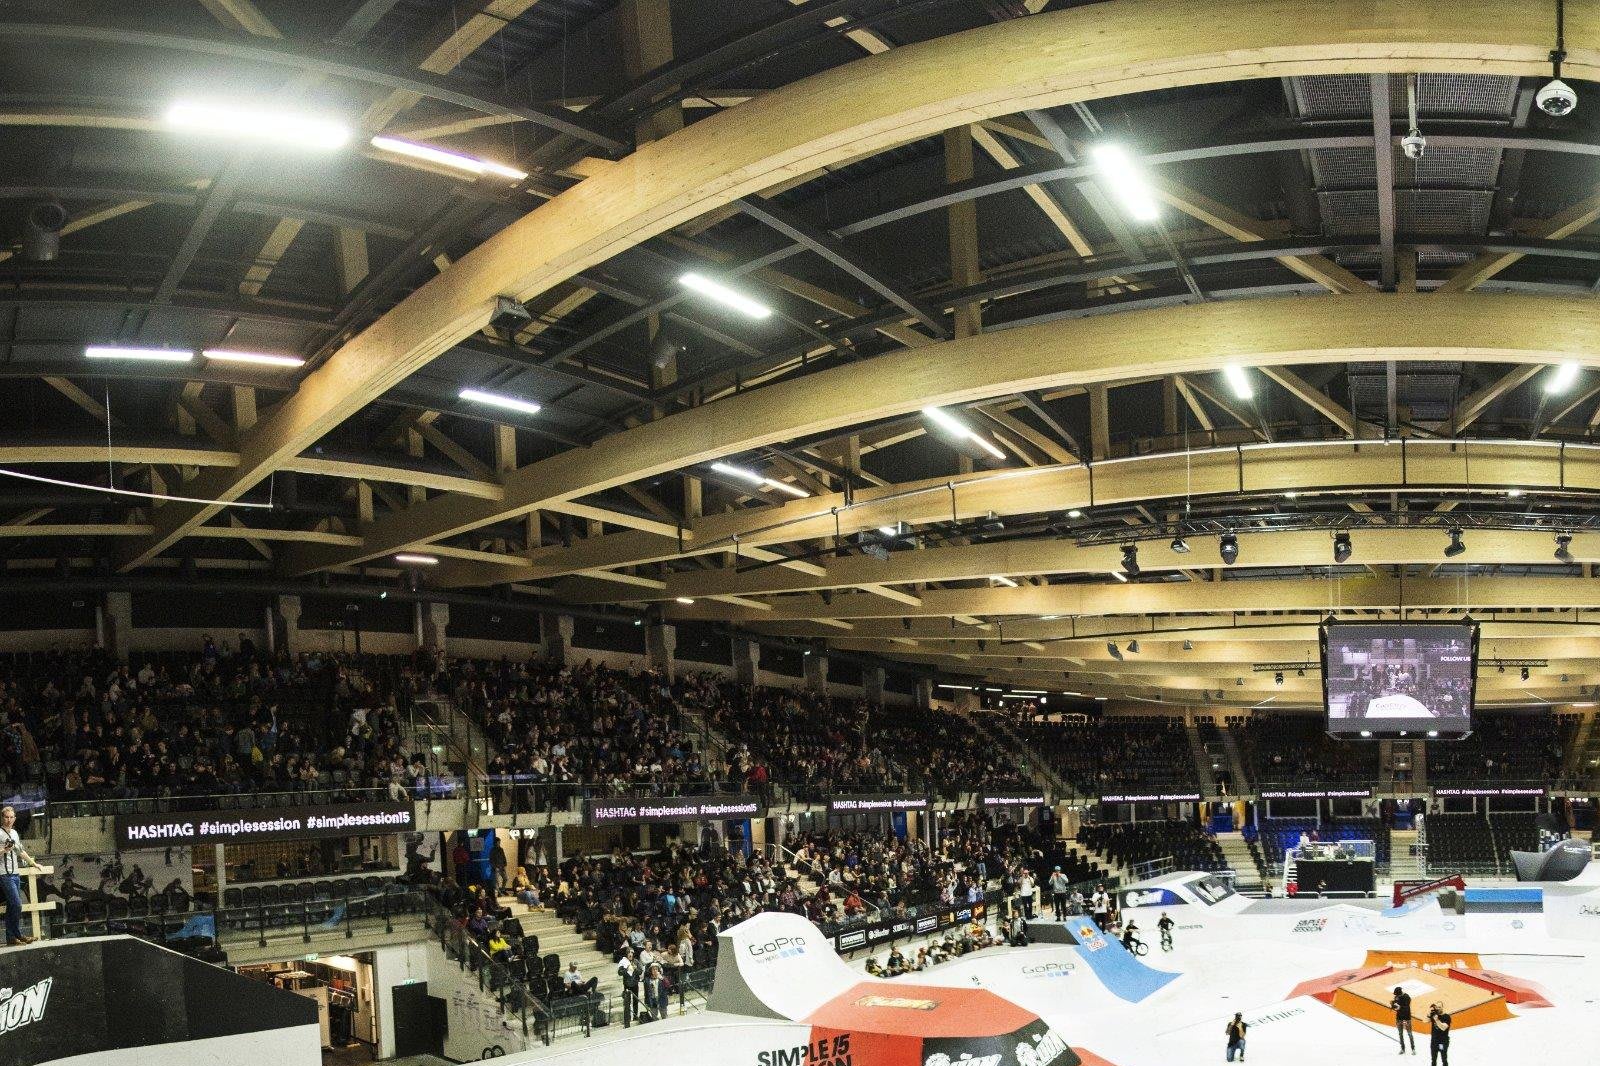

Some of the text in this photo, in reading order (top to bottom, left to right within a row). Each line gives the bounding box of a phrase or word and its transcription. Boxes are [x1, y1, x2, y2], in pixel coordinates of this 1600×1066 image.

[596, 803, 758, 818] HASHTAG #simplesession #simplesession15
[833, 800, 857, 809] HASHTAG
[128, 811, 411, 840] HASHTAG #simplesession #simplesession15
[748, 935, 806, 957] GoPro
[1022, 963, 1075, 975] GoPro
[831, 1033, 851, 1058] 15
